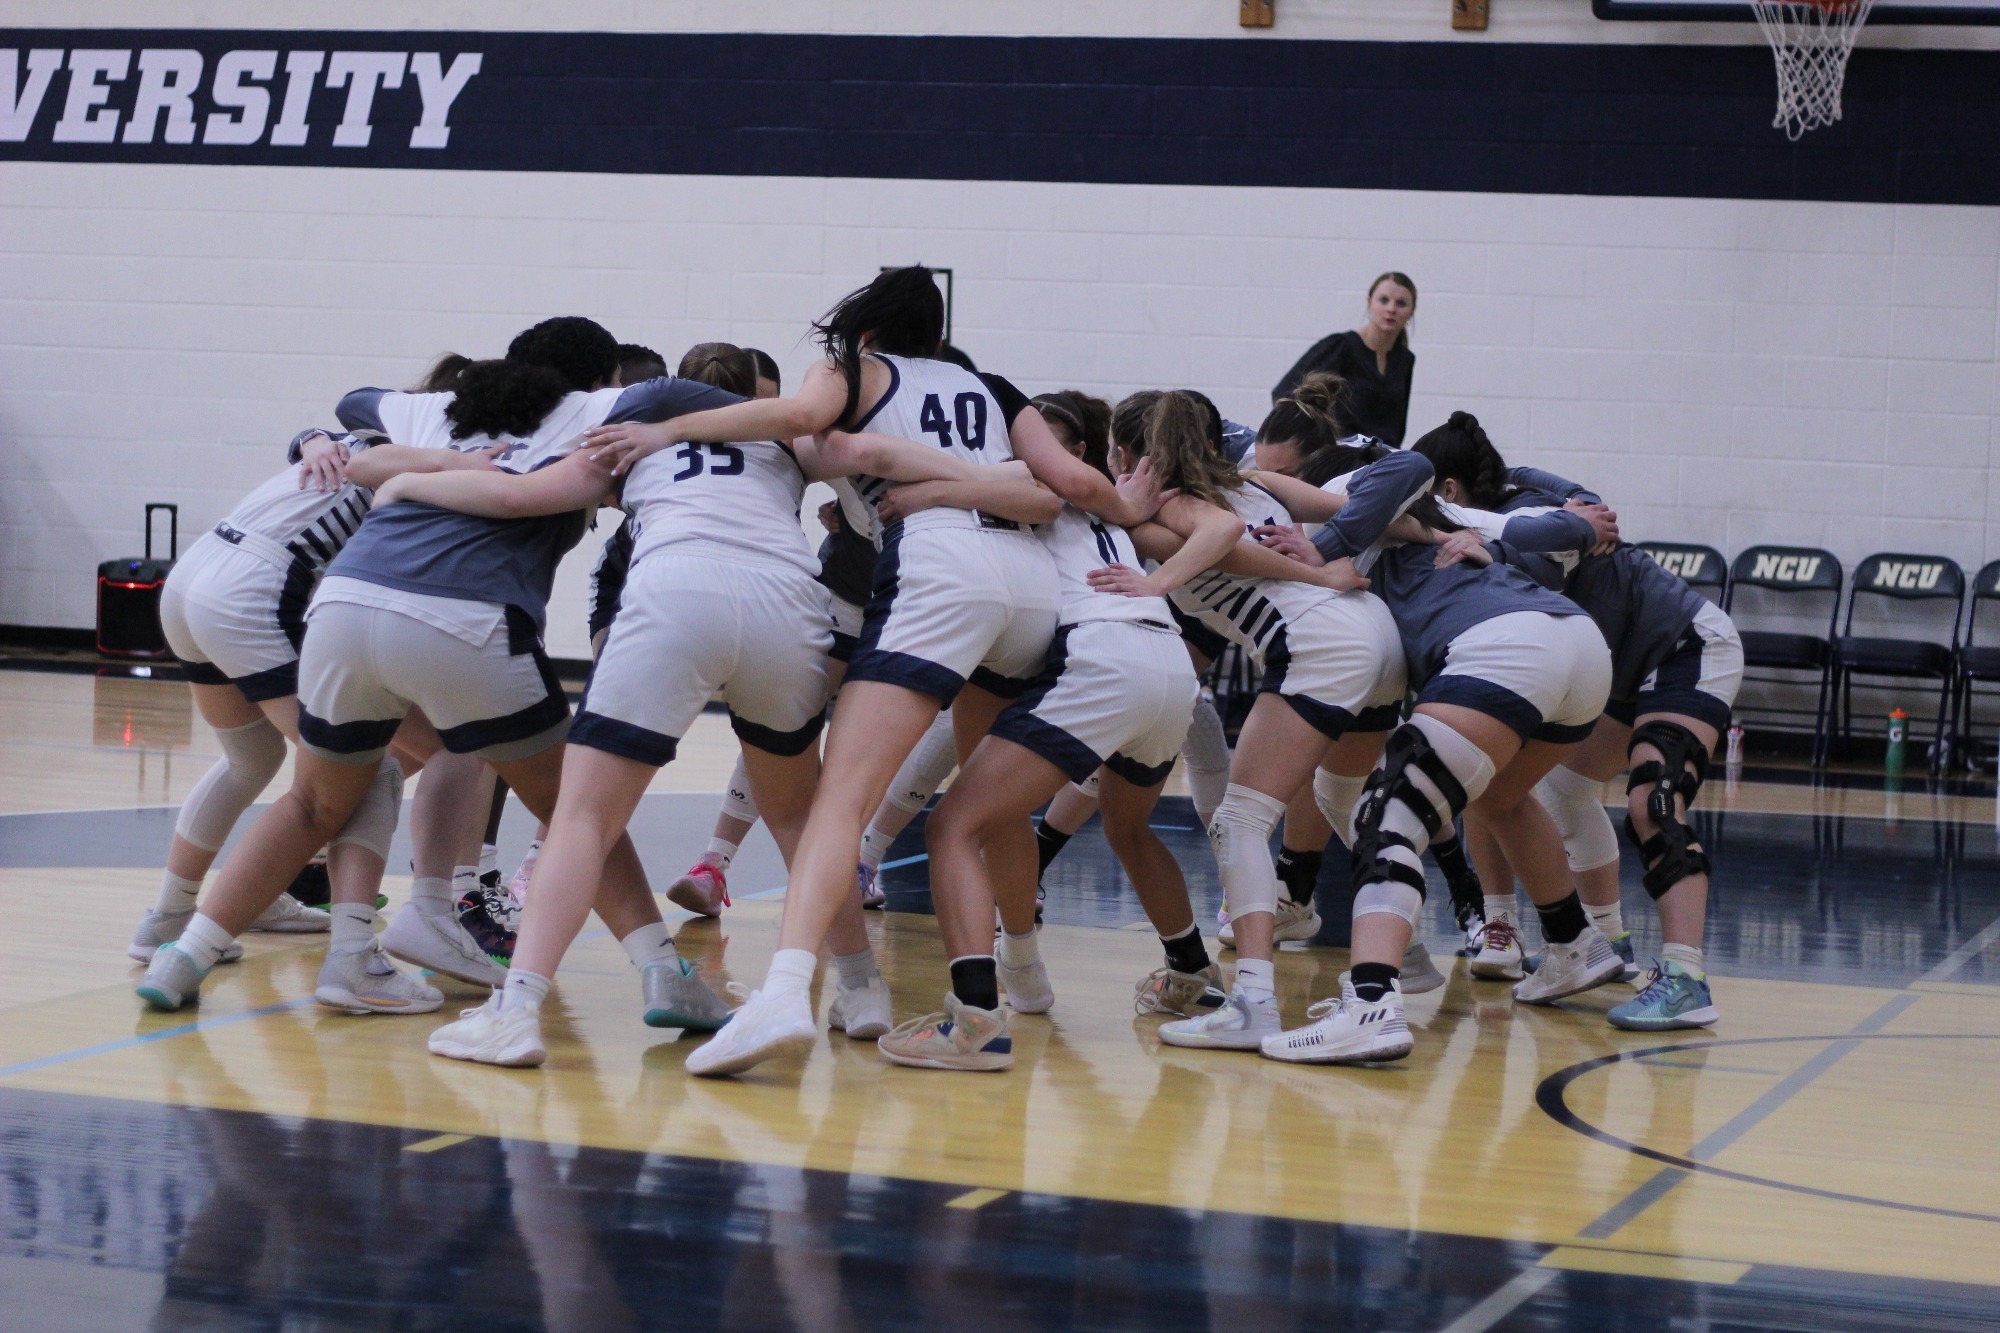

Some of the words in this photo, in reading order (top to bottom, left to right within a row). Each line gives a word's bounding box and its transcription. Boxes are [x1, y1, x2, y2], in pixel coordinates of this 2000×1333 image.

[0, 48, 483, 149] VERSITY
[920, 391, 988, 451] 40
[673, 441, 745, 483] 35
[1752, 554, 1821, 582] NCU
[1873, 561, 1943, 589] NCU
